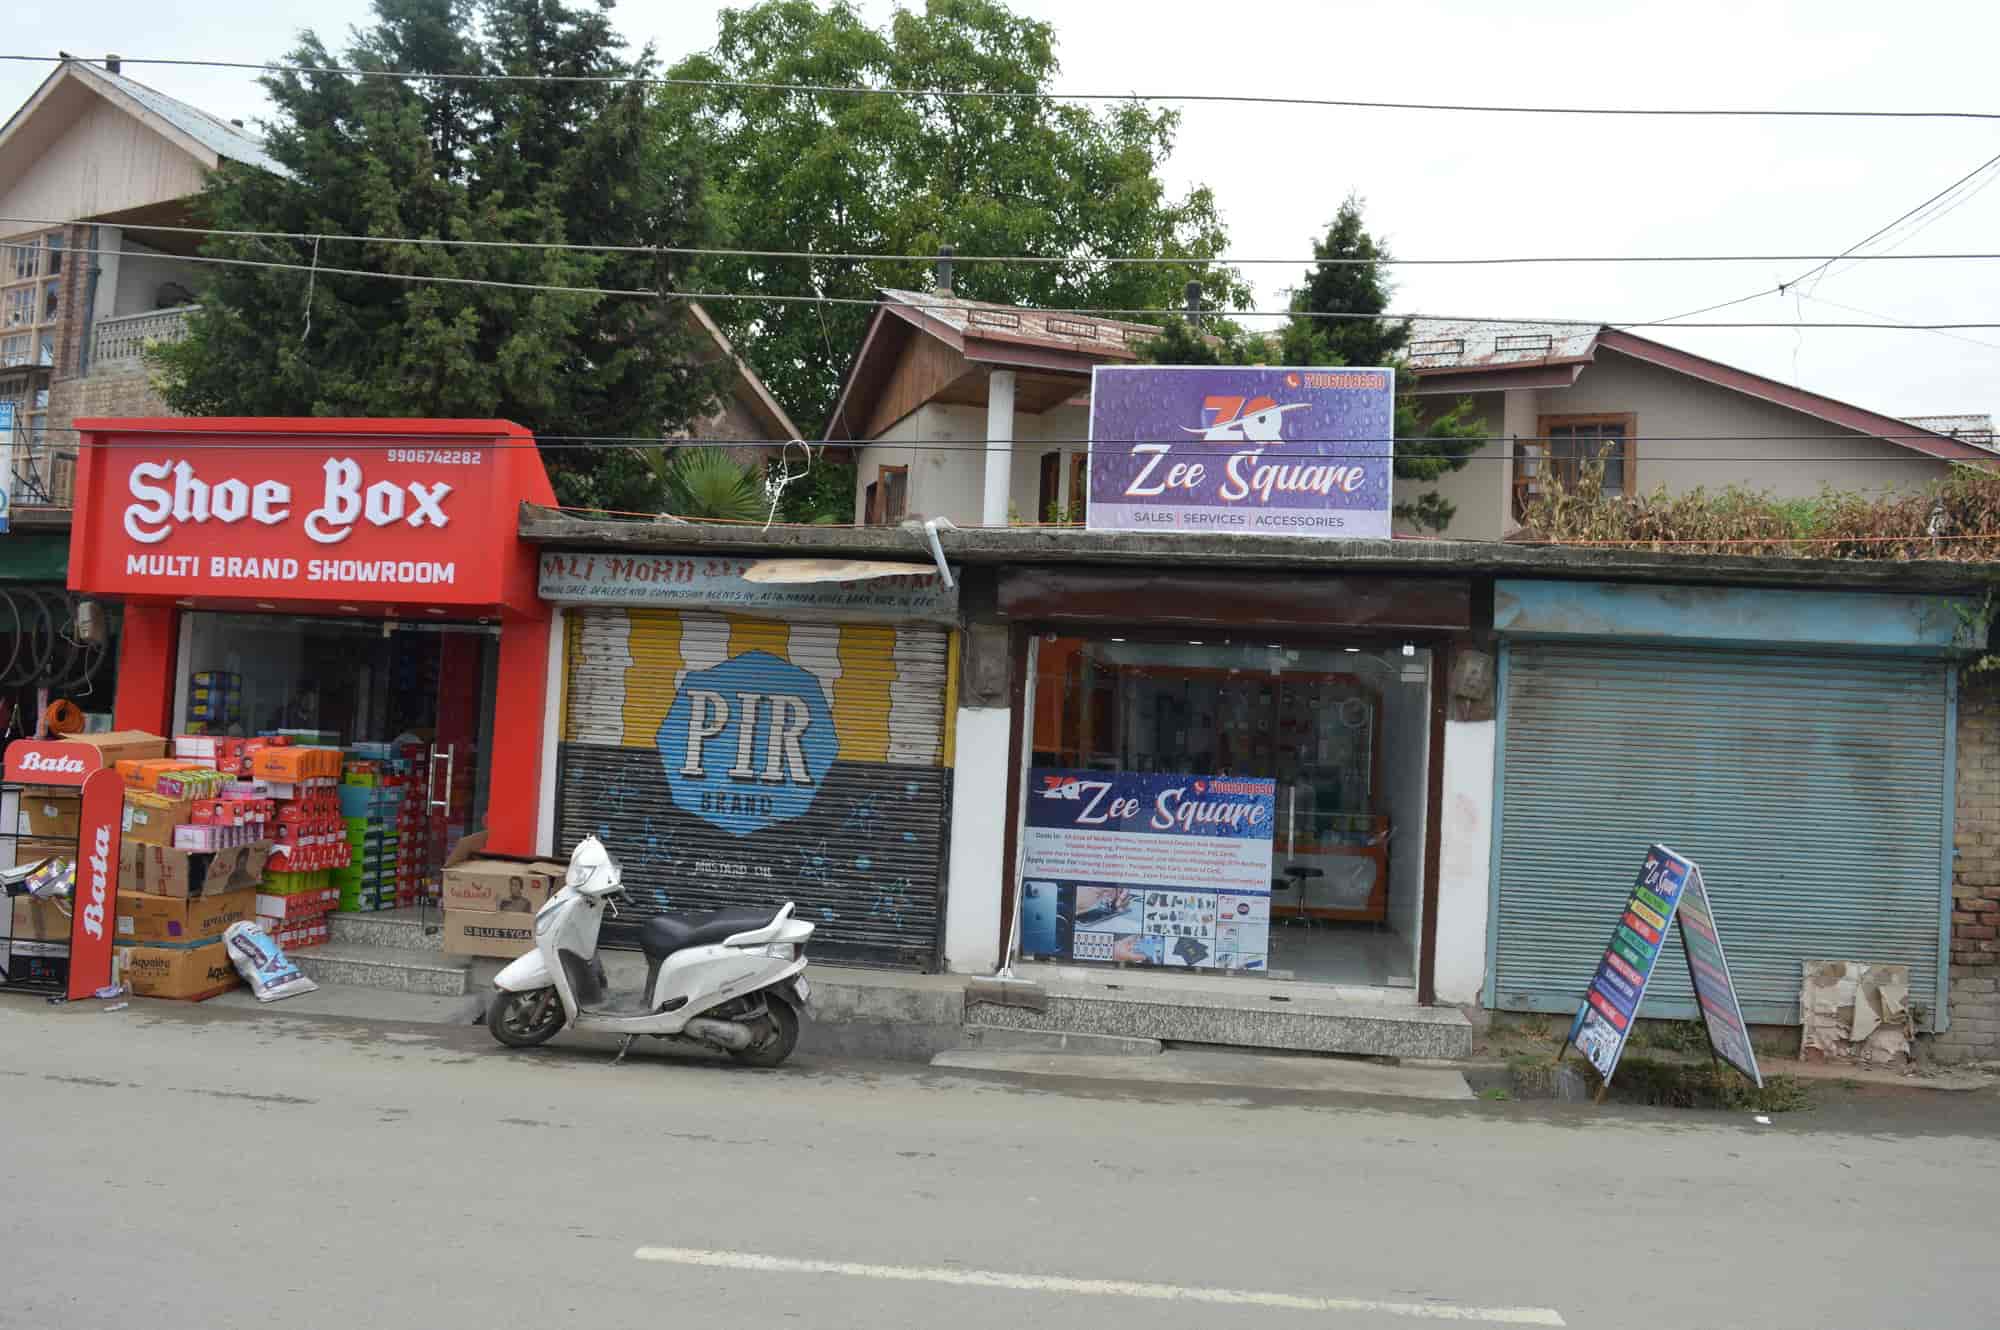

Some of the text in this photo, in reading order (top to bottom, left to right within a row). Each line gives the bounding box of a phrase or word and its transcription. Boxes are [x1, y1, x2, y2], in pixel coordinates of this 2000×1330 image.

[387, 448, 481, 465] 9906742282
[1125, 443, 1366, 502] Zee Square
[123, 456, 453, 543] Shoe Box
[1134, 511, 1345, 528] SALES SERVICES ACCESSORIES
[126, 554, 456, 585] MULTI BRAND SHOWROOM
[679, 690, 812, 785] PIR
[19, 751, 85, 773] Bata
[701, 791, 775, 816] BRAND
[1075, 781, 1265, 832] Zee Square
[84, 824, 112, 940] Bata
